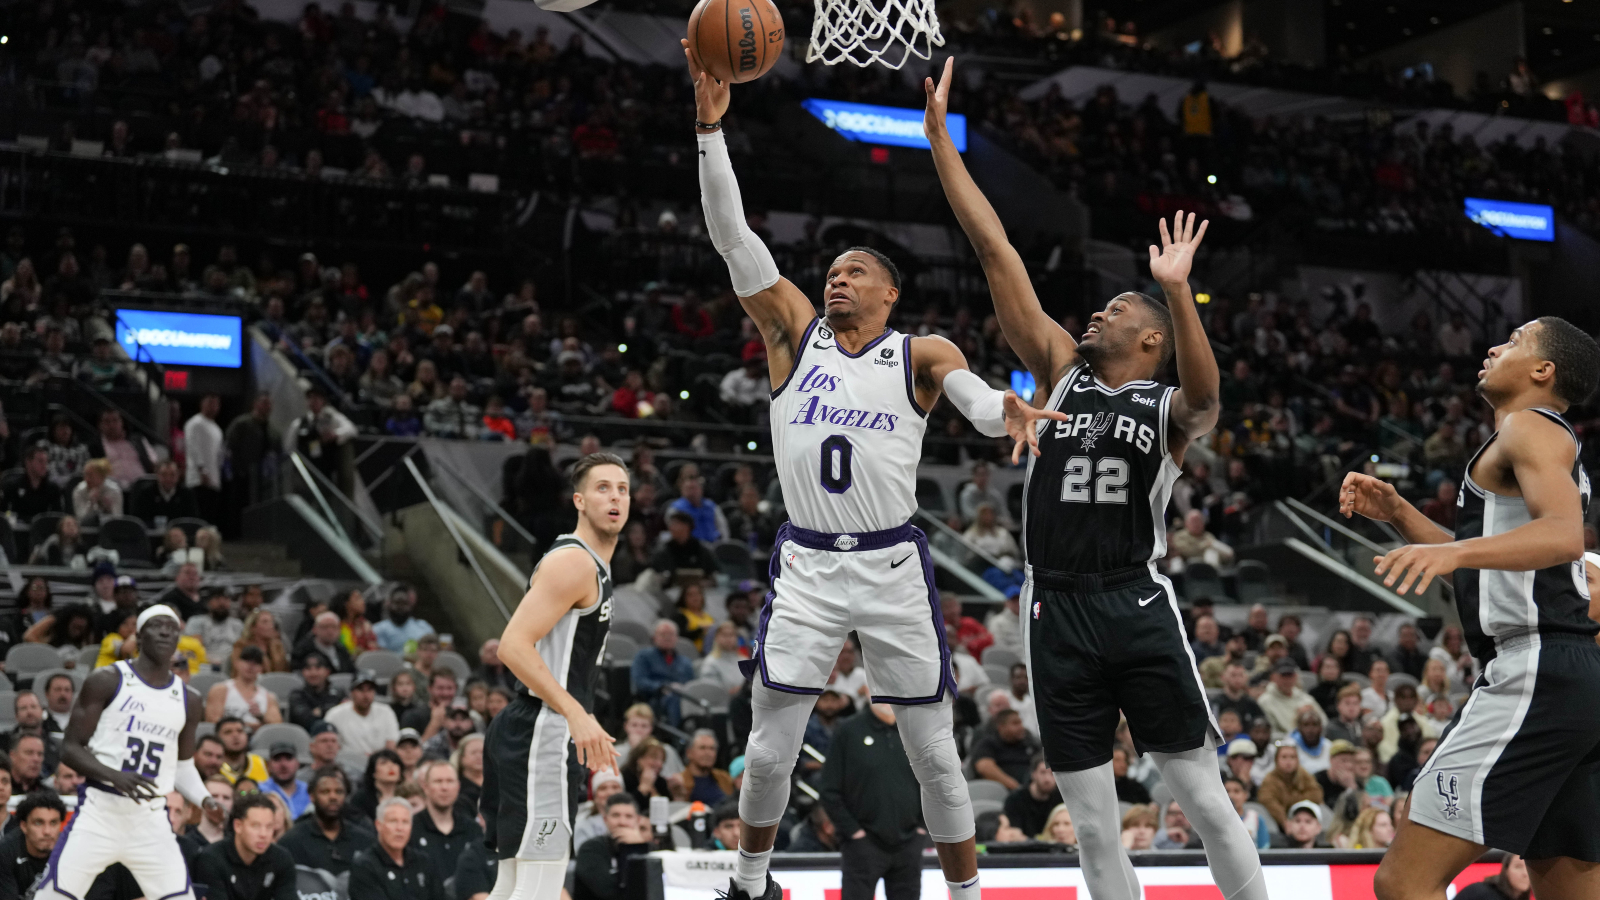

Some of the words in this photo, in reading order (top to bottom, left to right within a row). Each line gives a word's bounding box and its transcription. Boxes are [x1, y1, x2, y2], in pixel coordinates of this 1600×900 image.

[739, 7, 757, 73] Wilson
[874, 358, 899, 368] bibigo
[821, 435, 853, 494] 0
[1060, 455, 1130, 504] 22
[121, 736, 165, 778] 35
[686, 861, 738, 870] GATORA
